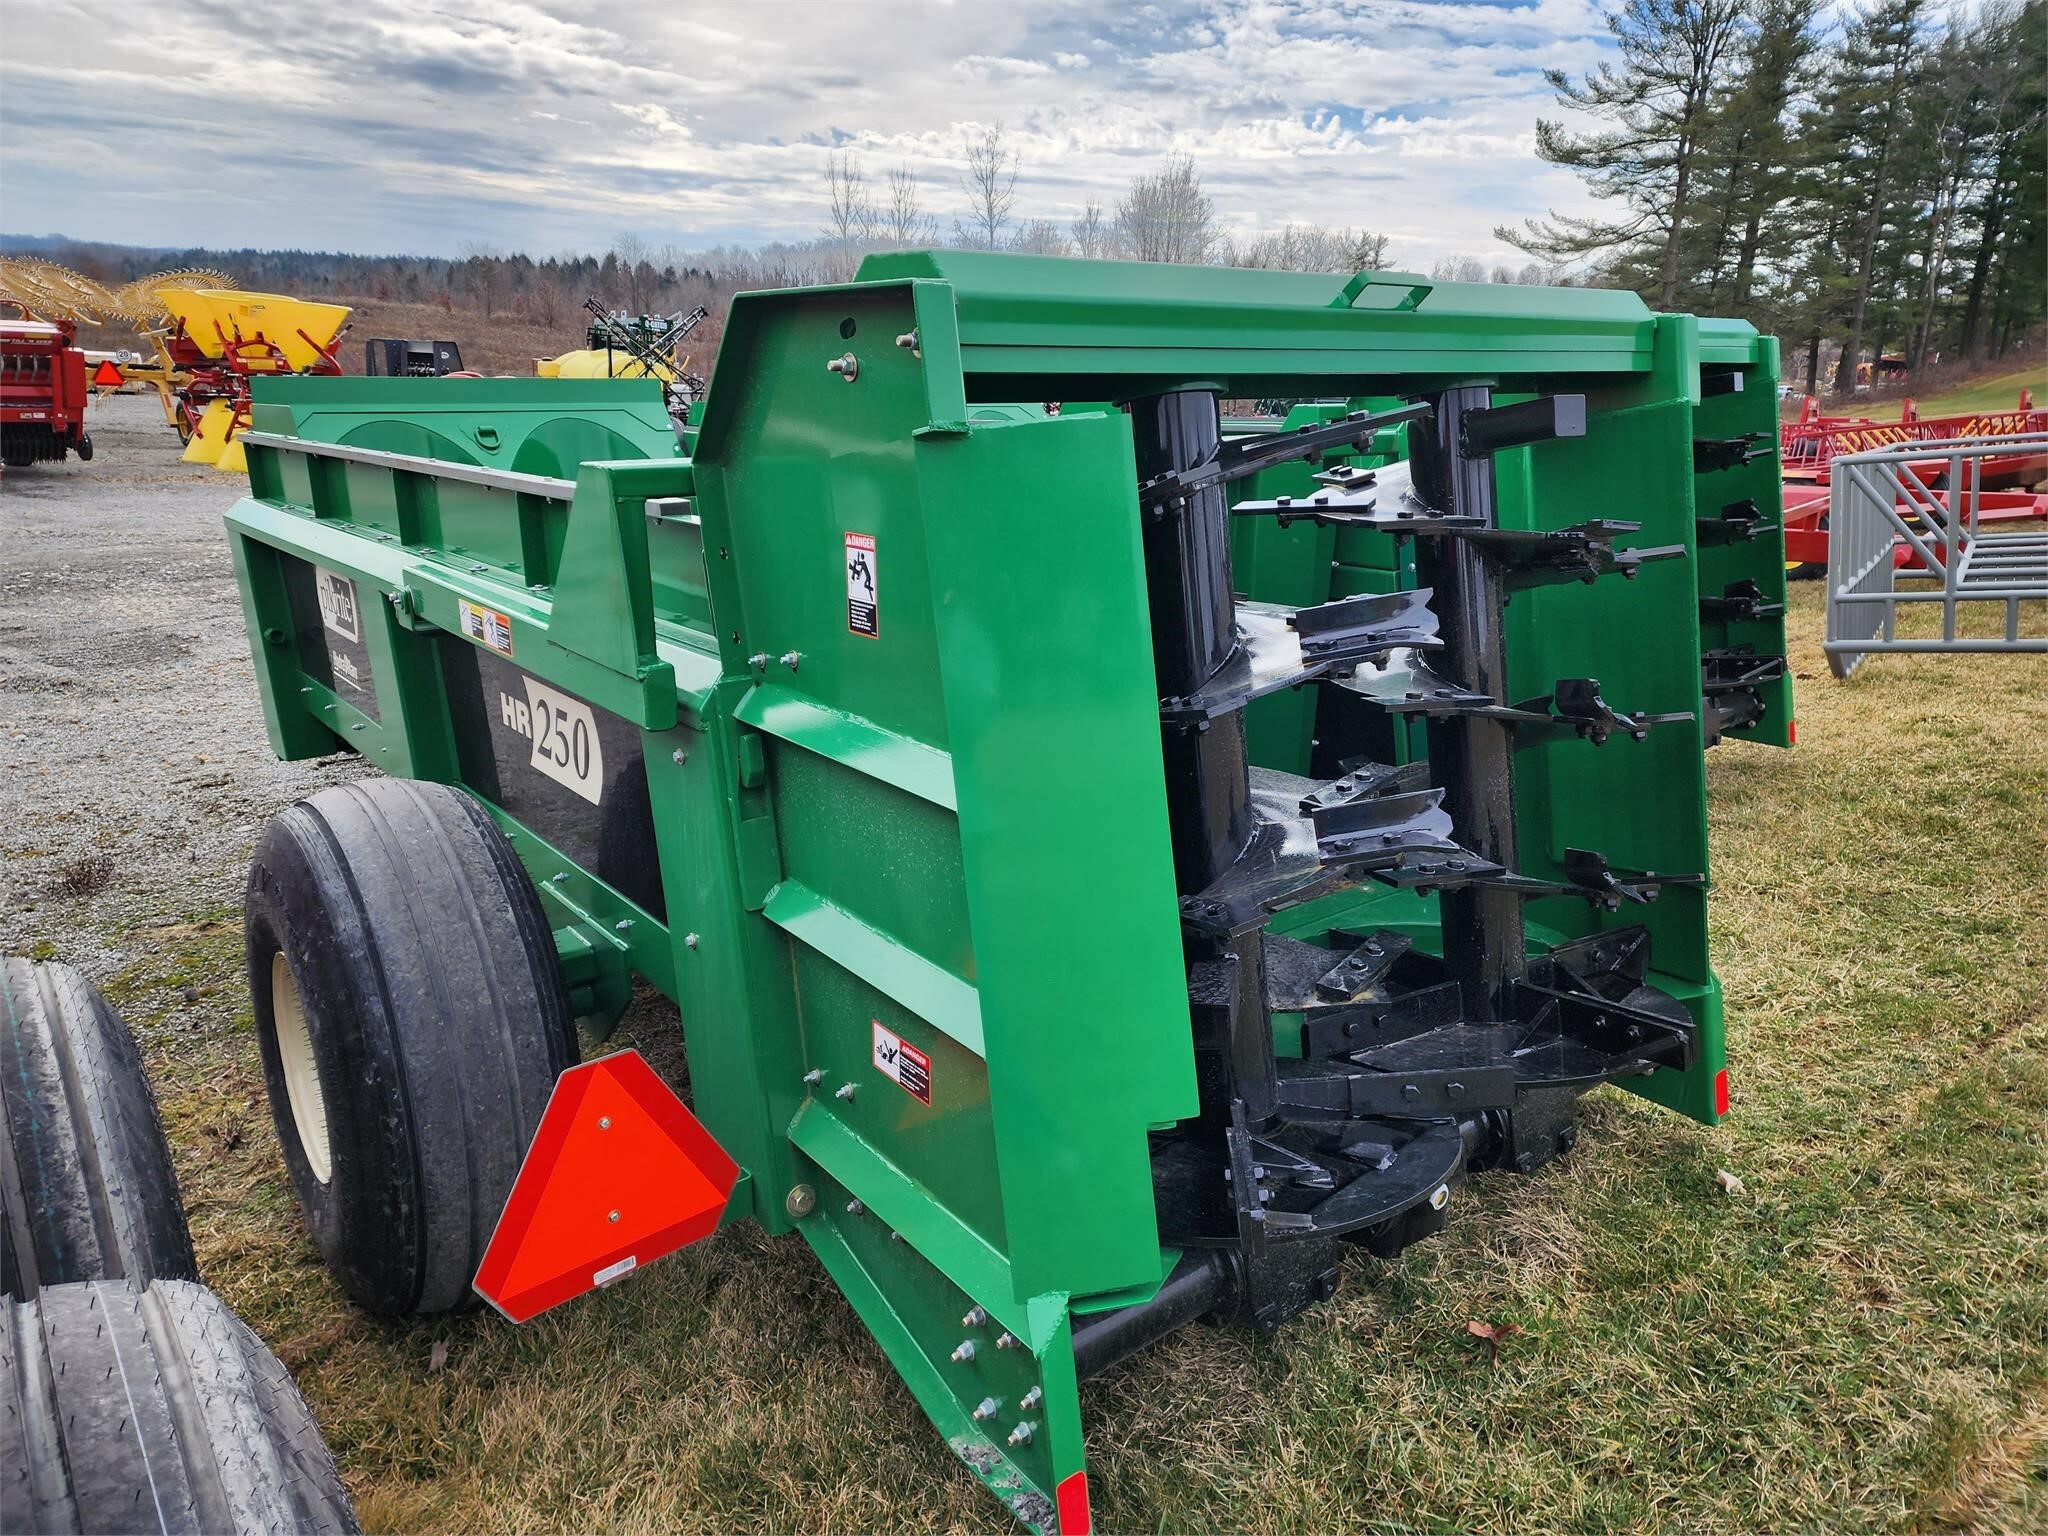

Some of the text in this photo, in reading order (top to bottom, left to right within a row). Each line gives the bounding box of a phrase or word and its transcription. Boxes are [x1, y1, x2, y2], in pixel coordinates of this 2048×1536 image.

[119, 350, 128, 358] 20
[851, 535, 874, 550] DANGER
[500, 691, 590, 781] HR 250
[905, 1047, 927, 1066] DANGER
